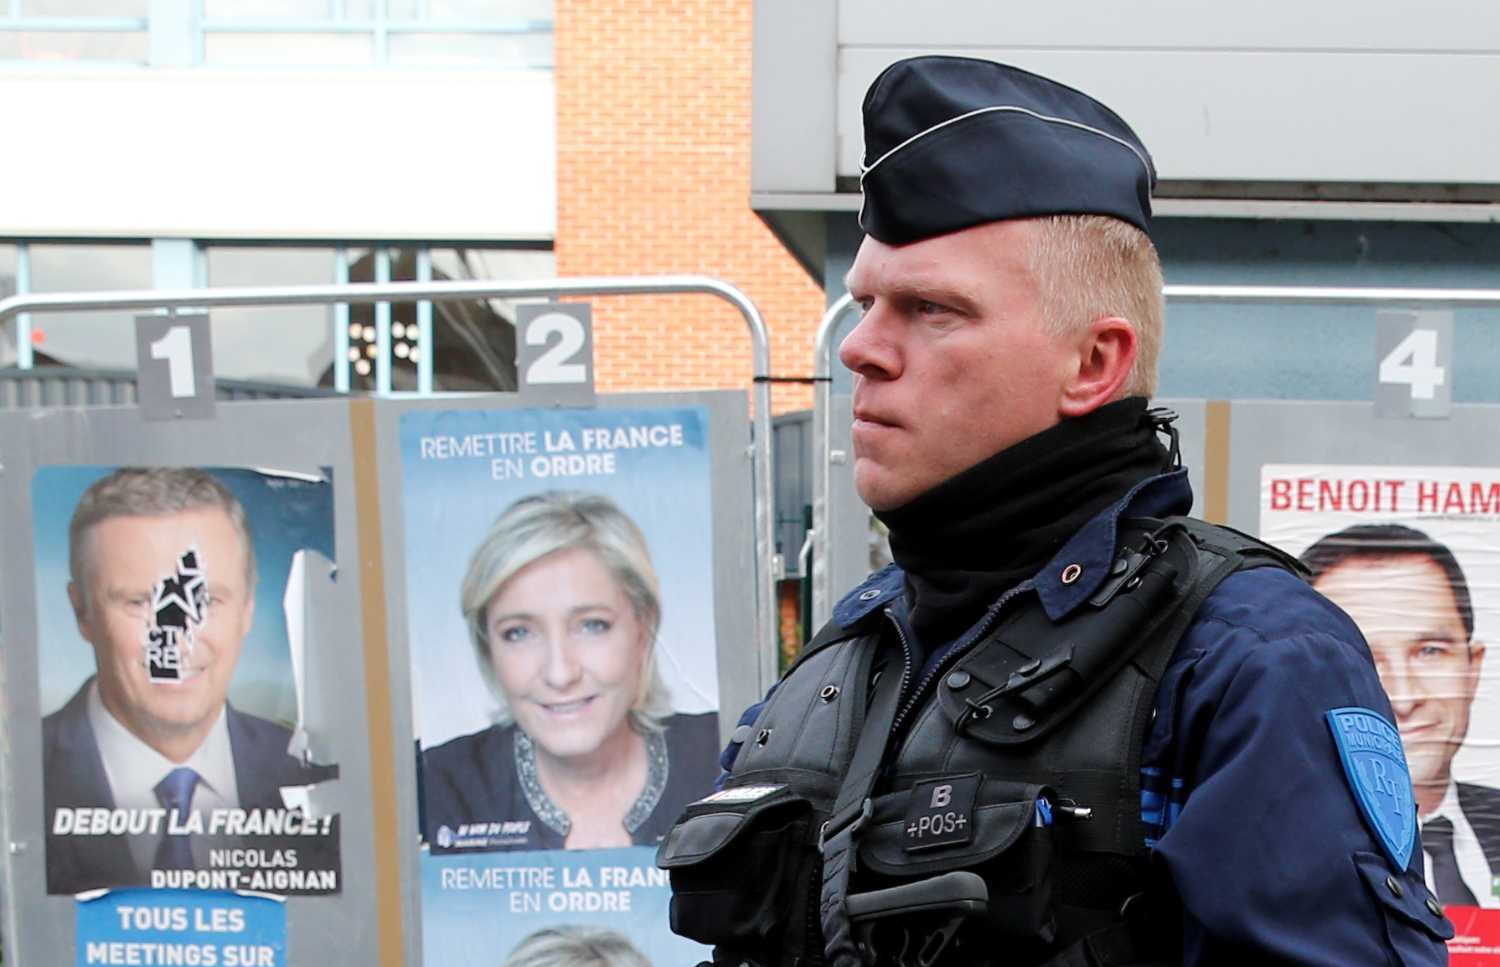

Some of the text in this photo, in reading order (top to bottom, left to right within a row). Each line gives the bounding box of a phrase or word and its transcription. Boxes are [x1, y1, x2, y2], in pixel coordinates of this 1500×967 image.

[150, 325, 195, 397] 1
[525, 313, 587, 383] 2
[1379, 329, 1444, 399] 4
[420, 424, 683, 459] REMETTRE LA FRANCE
[491, 454, 616, 480] EN ORDRE
[1270, 478, 1405, 512] BENOIT
[929, 785, 953, 808] B
[53, 808, 166, 835] DEBOUT
[168, 811, 203, 834] LA
[209, 849, 297, 868] NICOLAS
[151, 870, 337, 890] DUPONT-AIGNAN
[441, 867, 556, 889] REMETTRE
[562, 867, 592, 888] LA
[510, 891, 631, 912] EN ORDRE
[117, 906, 245, 932] TOUS LES
[86, 943, 275, 967] MEETINGS SUR
